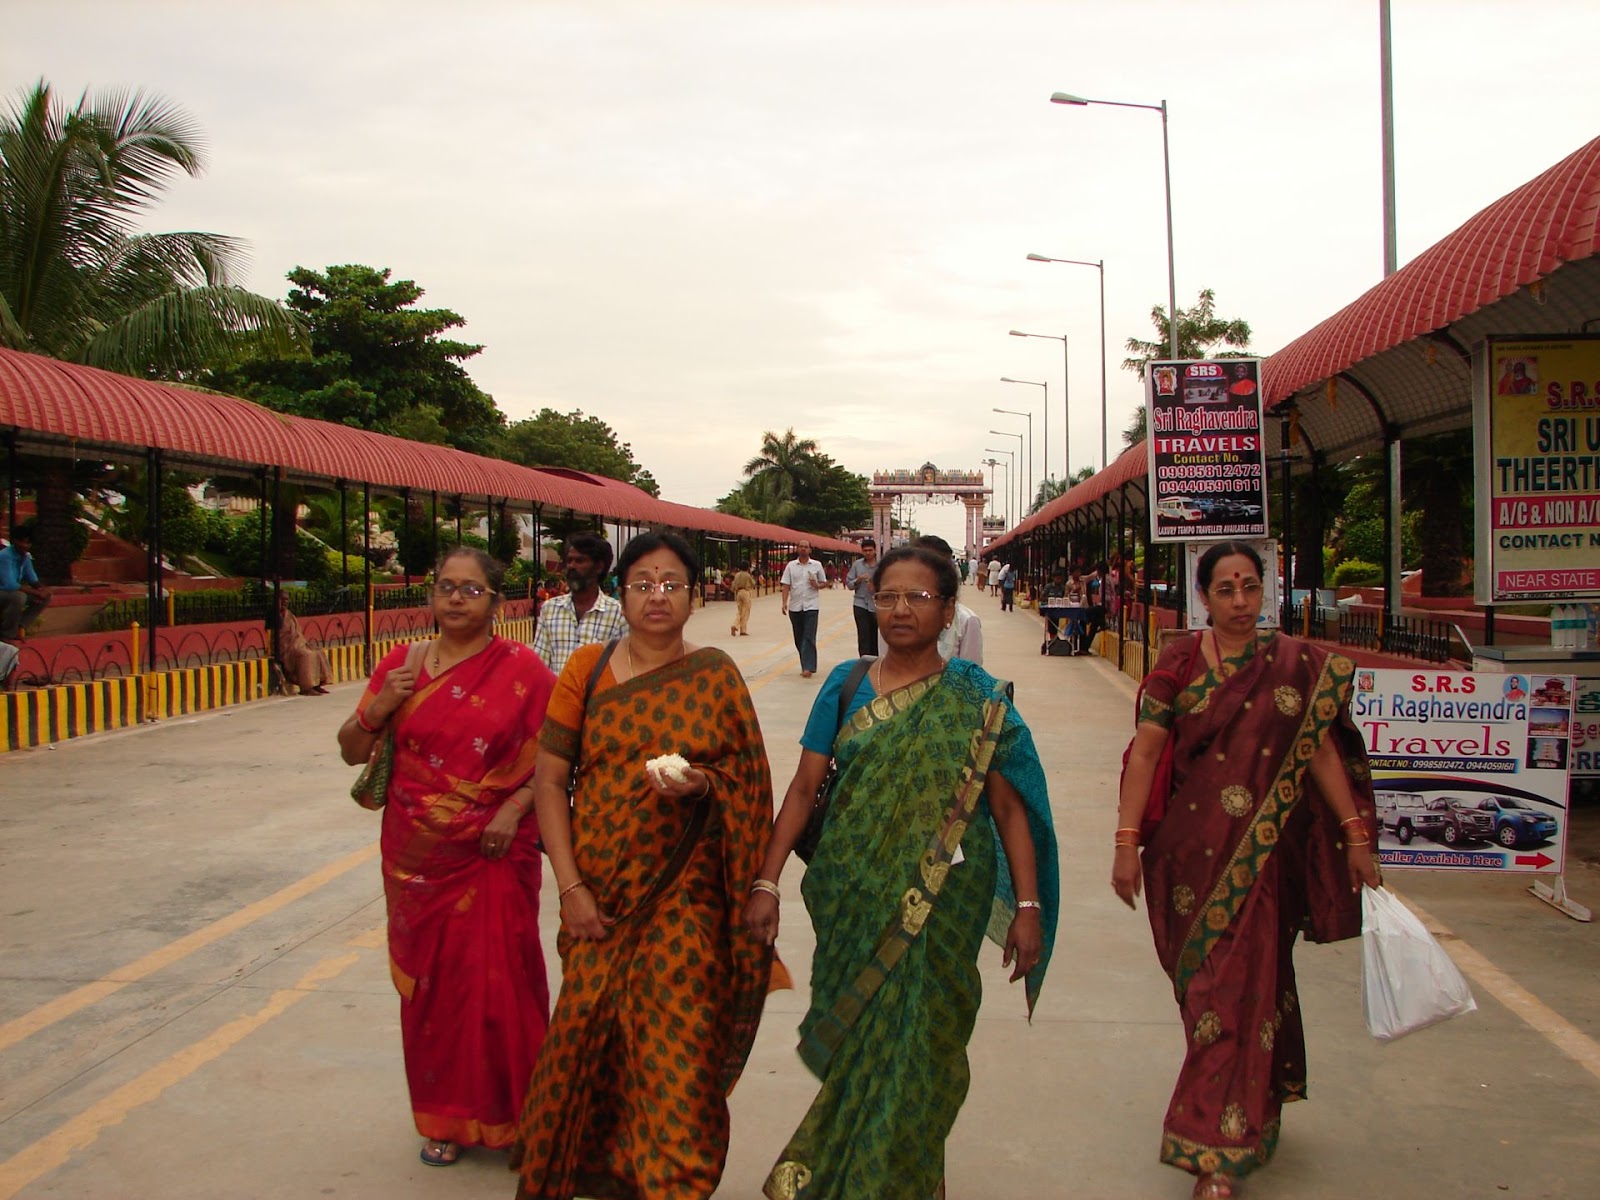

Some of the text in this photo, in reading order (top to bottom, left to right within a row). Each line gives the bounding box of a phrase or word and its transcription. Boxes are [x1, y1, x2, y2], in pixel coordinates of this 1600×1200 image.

[1190, 365, 1217, 376] SRS
[1154, 405, 1258, 436] Sri Raghavendra
[1537, 418, 1576, 453] SRI
[1158, 436, 1255, 453] TRAVELS
[1173, 453, 1219, 464] Contact
[1159, 464, 1261, 479] 09985812472
[1159, 478, 1260, 494] 09440591611
[1499, 501, 1528, 526] A/C
[1530, 504, 1542, 526] &
[1544, 500, 1575, 525] NON
[1177, 525, 1196, 535] TEMPO
[1196, 524, 1223, 535] TRAVELLER
[1223, 523, 1250, 534] AVAILABLE
[1250, 523, 1264, 533] HERE
[1499, 533, 1584, 549] CONTACT
[1505, 571, 1596, 588] NEAR STATE
[1411, 674, 1477, 694] S.R.S
[1355, 692, 1527, 724] Sri Raghavendra
[1362, 721, 1512, 757] Travels
[1368, 758, 1396, 769] ONTACT
[1466, 761, 1515, 772] 09440591611
[1414, 853, 1471, 866] Available
[1472, 854, 1503, 868] Here
